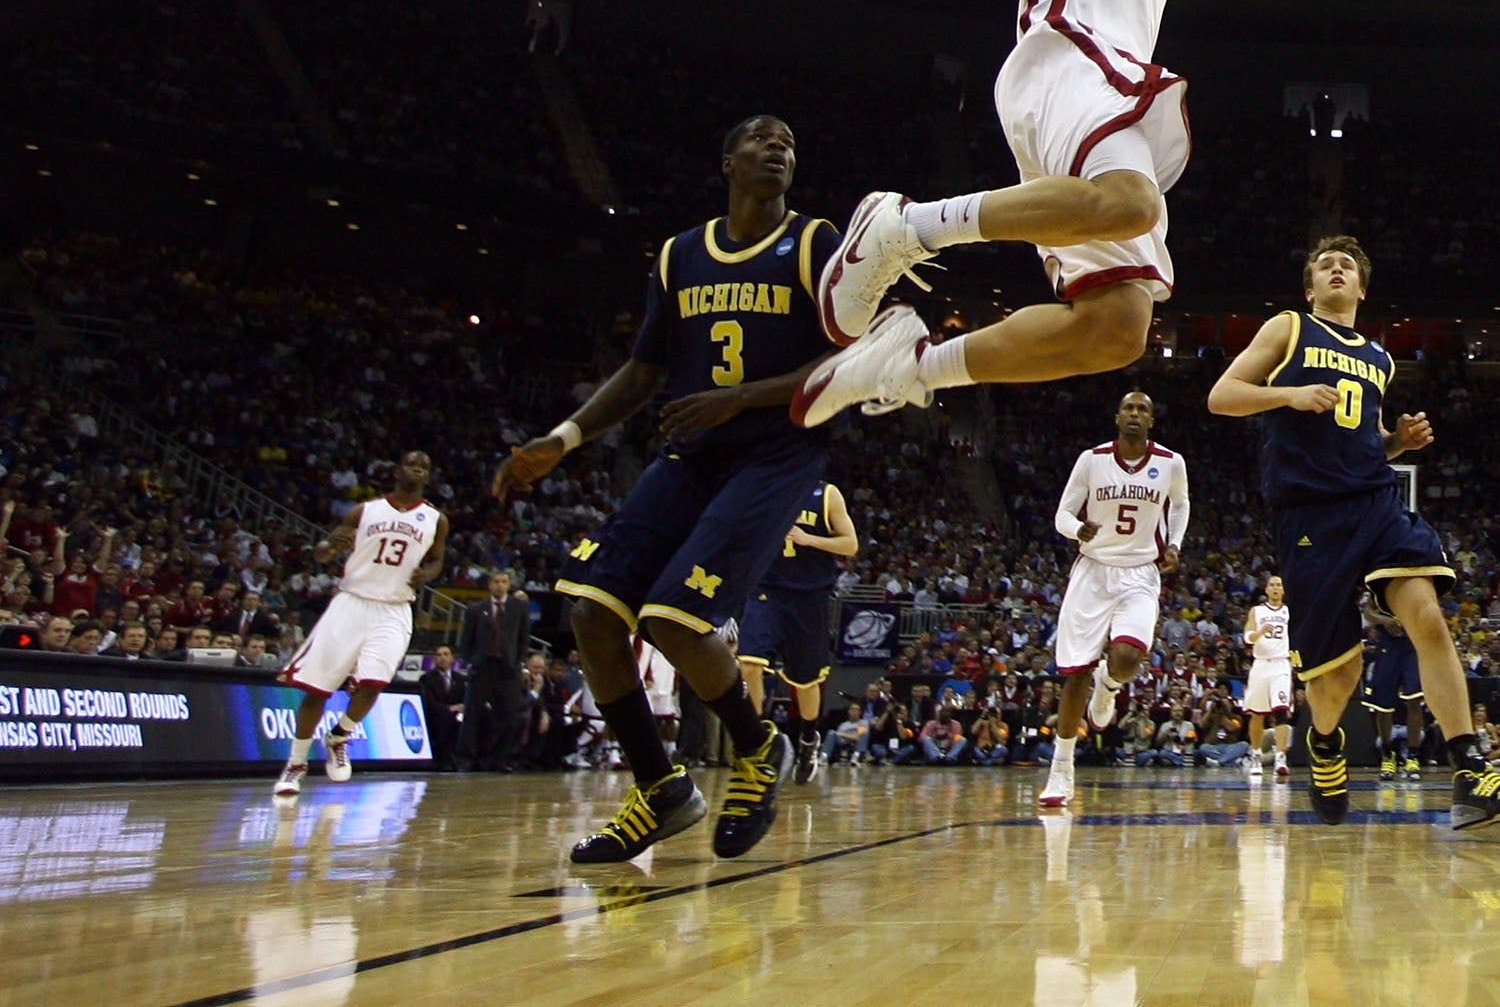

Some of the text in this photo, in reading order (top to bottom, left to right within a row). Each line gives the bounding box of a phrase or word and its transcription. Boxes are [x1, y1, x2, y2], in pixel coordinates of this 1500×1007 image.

[678, 283, 792, 319] MICHIGAN
[711, 320, 744, 387] 3
[1334, 378, 1363, 430] 0
[1096, 484, 1160, 505] OKLAHOMA
[367, 521, 424, 545] OKLAHOMA
[1115, 504, 1138, 535] 5
[373, 537, 408, 567] 13
[684, 564, 723, 599] M
[23, 687, 61, 716] AND
[63, 688, 128, 718] SECOND
[129, 692, 189, 720] ROUNDS
[40, 722, 77, 751] CITY,
[76, 724, 143, 747] MISSOURI
